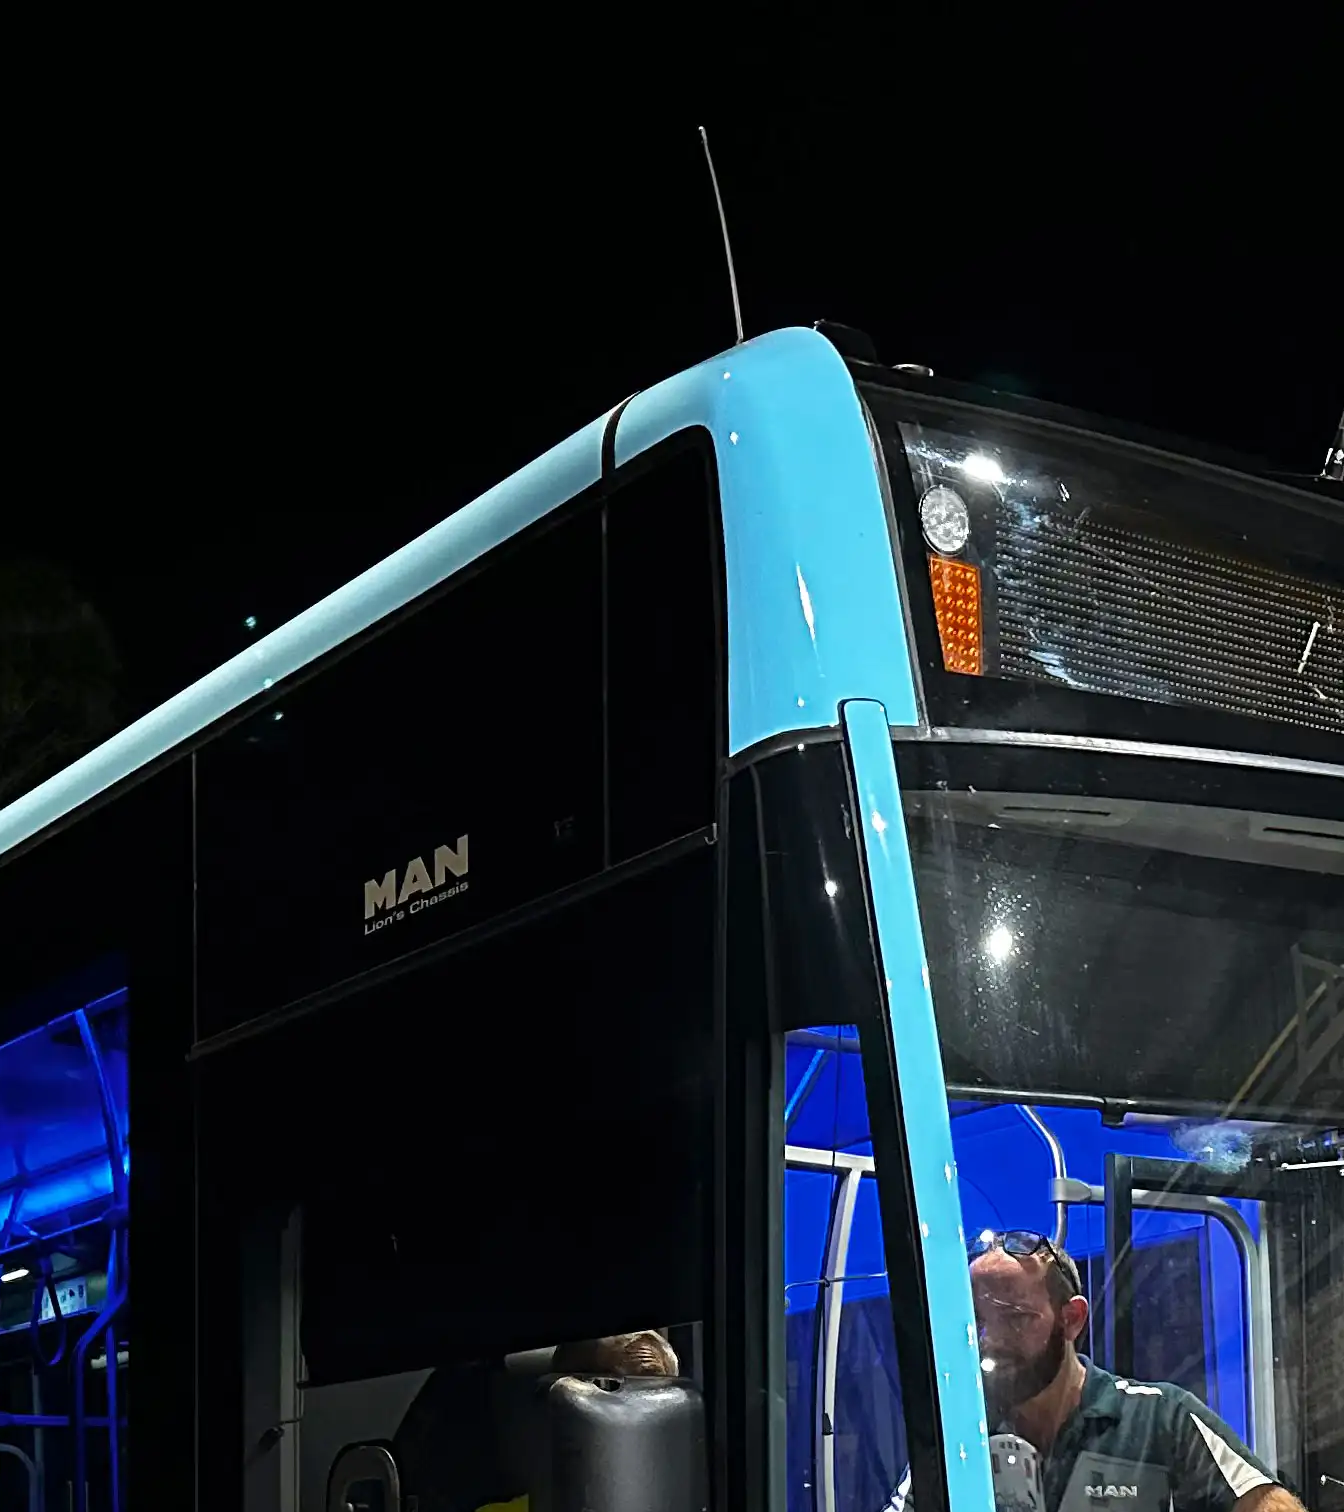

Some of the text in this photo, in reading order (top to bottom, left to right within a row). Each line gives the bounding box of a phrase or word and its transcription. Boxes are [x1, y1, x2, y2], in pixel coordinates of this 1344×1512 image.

[364, 834, 469, 920] MAN
[364, 881, 469, 936] Lion's Chassis
[1084, 1485, 1138, 1498] MAN
